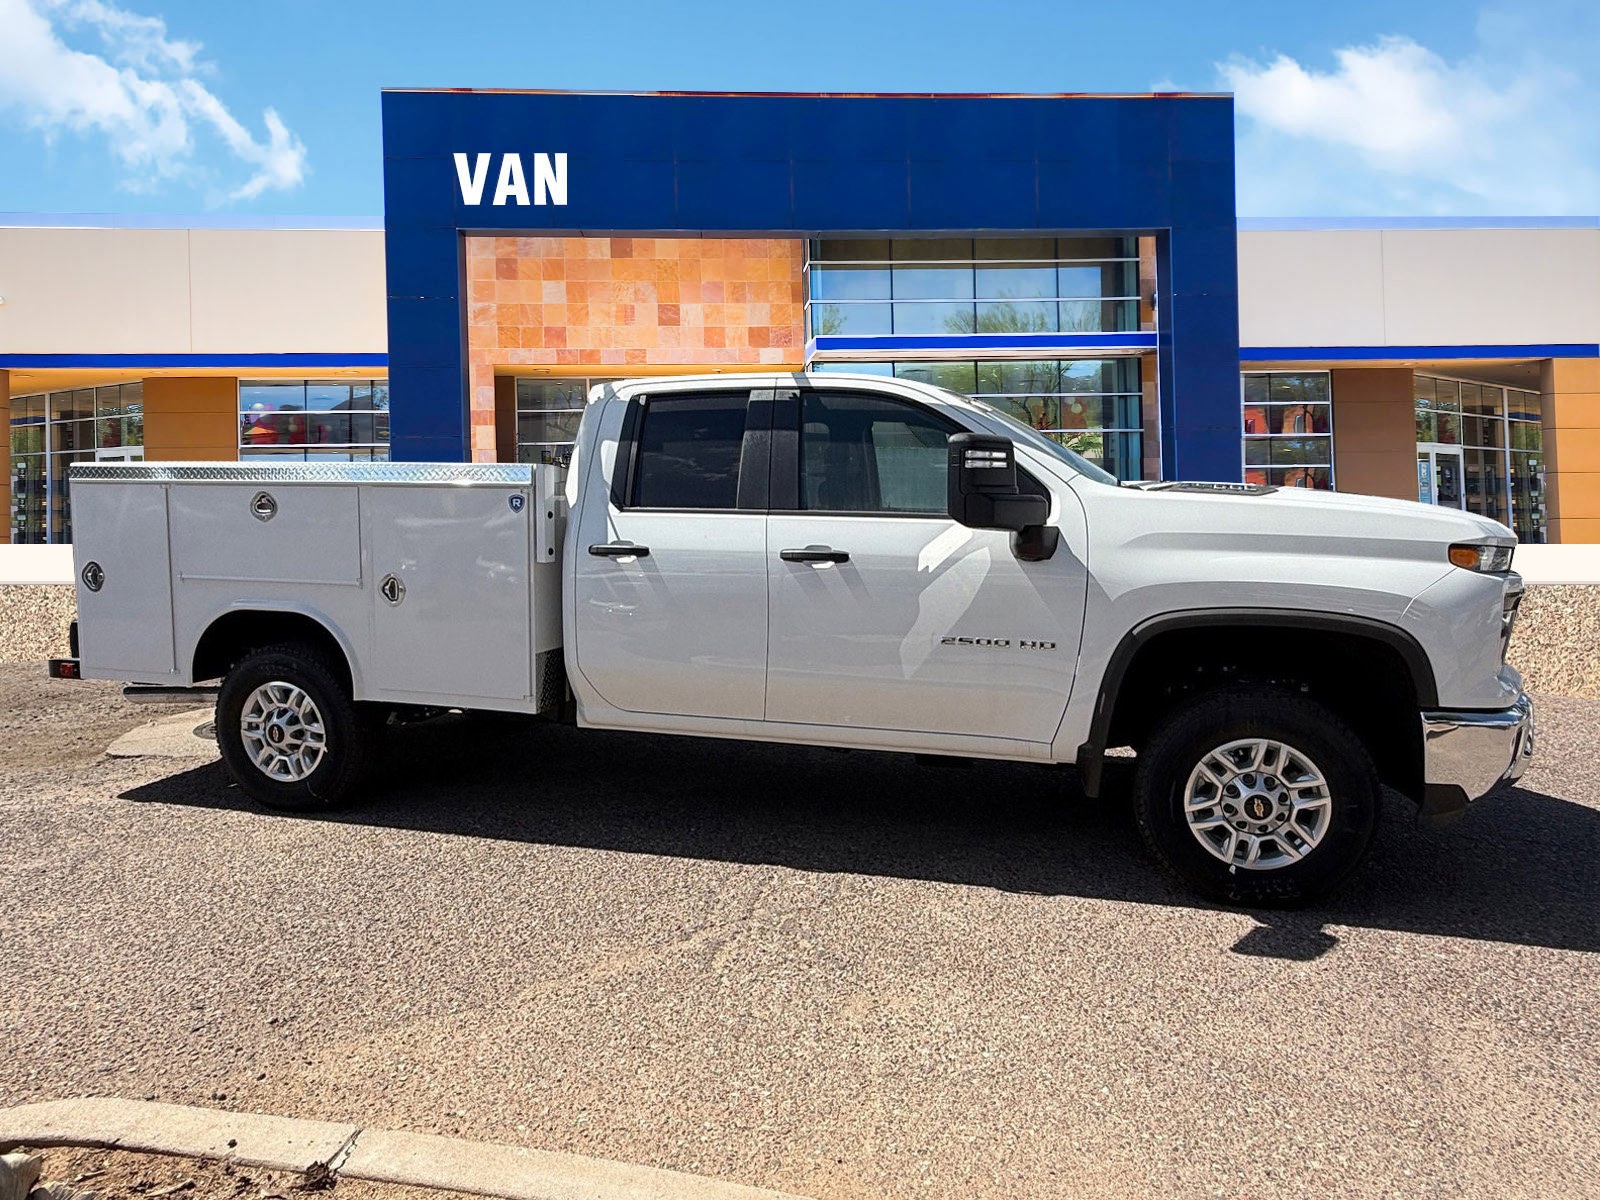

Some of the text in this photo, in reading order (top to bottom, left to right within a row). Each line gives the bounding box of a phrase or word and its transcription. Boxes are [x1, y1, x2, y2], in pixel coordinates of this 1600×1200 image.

[453, 152, 568, 206] VAN
[940, 636, 1056, 651] 2500 HD
